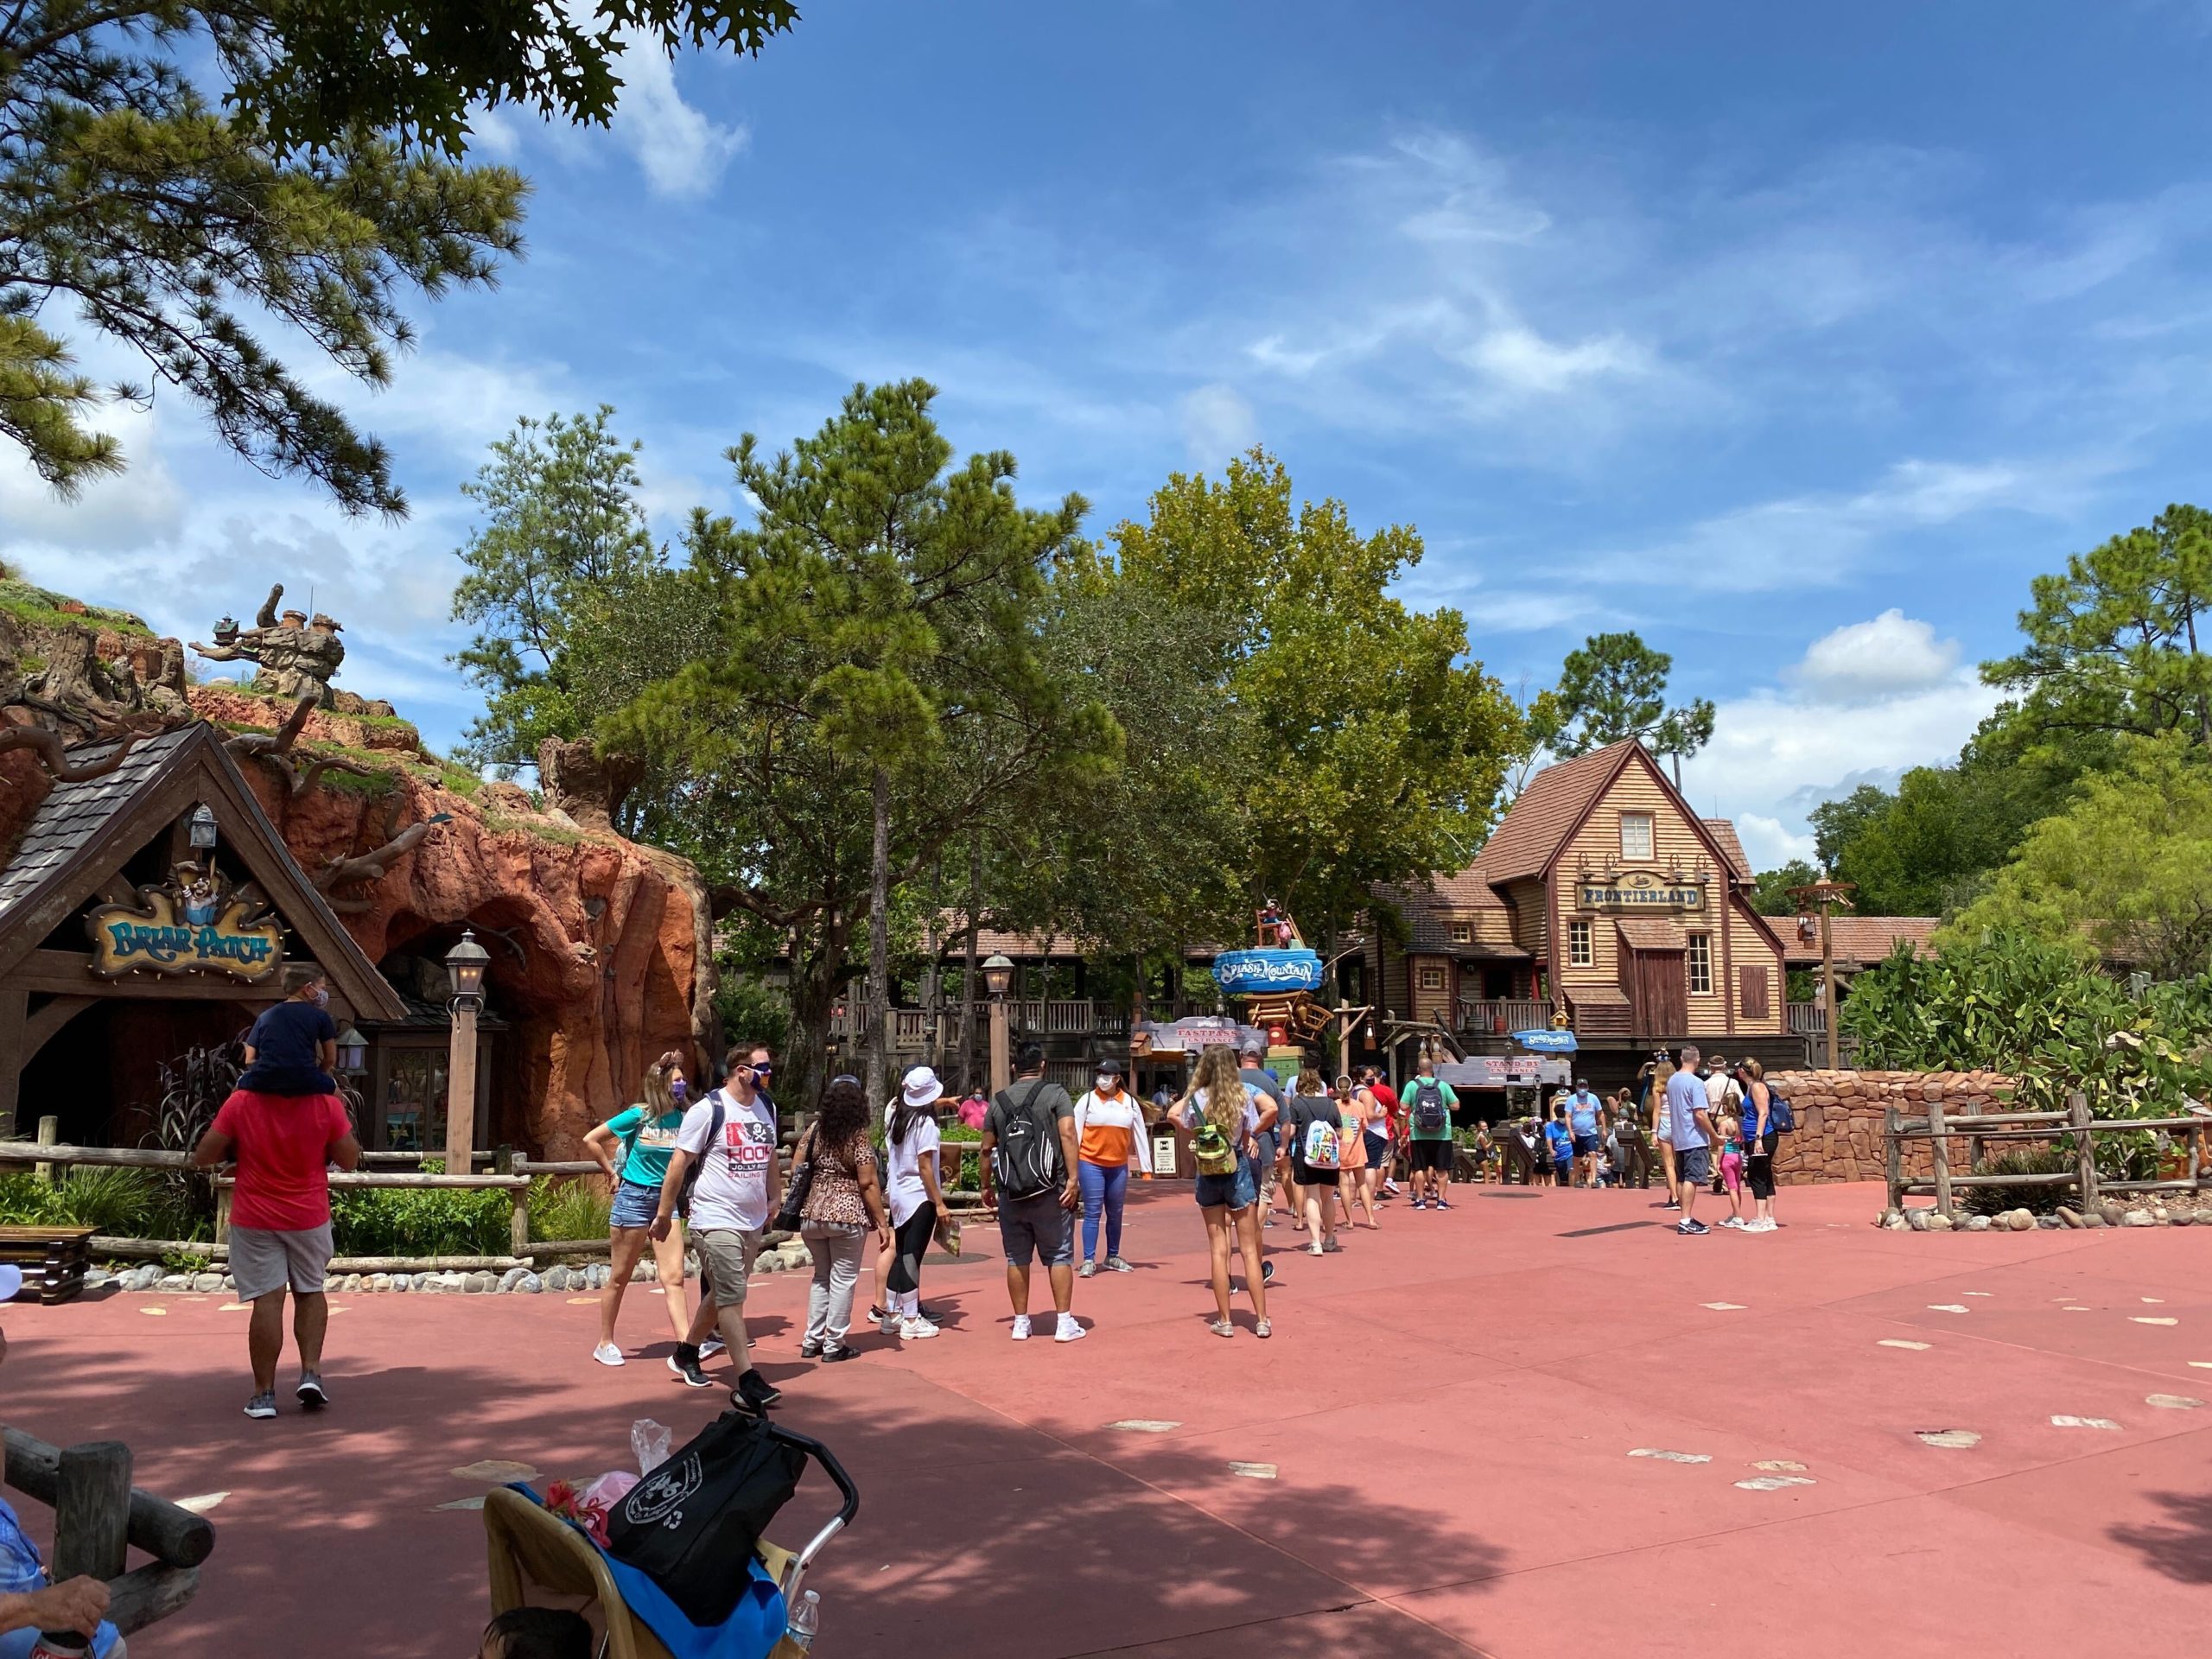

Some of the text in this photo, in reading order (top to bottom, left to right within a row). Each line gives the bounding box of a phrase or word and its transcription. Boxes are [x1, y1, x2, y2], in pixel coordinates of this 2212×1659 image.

[1584, 889, 1698, 905] FRONTIERLAND
[108, 922, 273, 964] BRIAR PATCH
